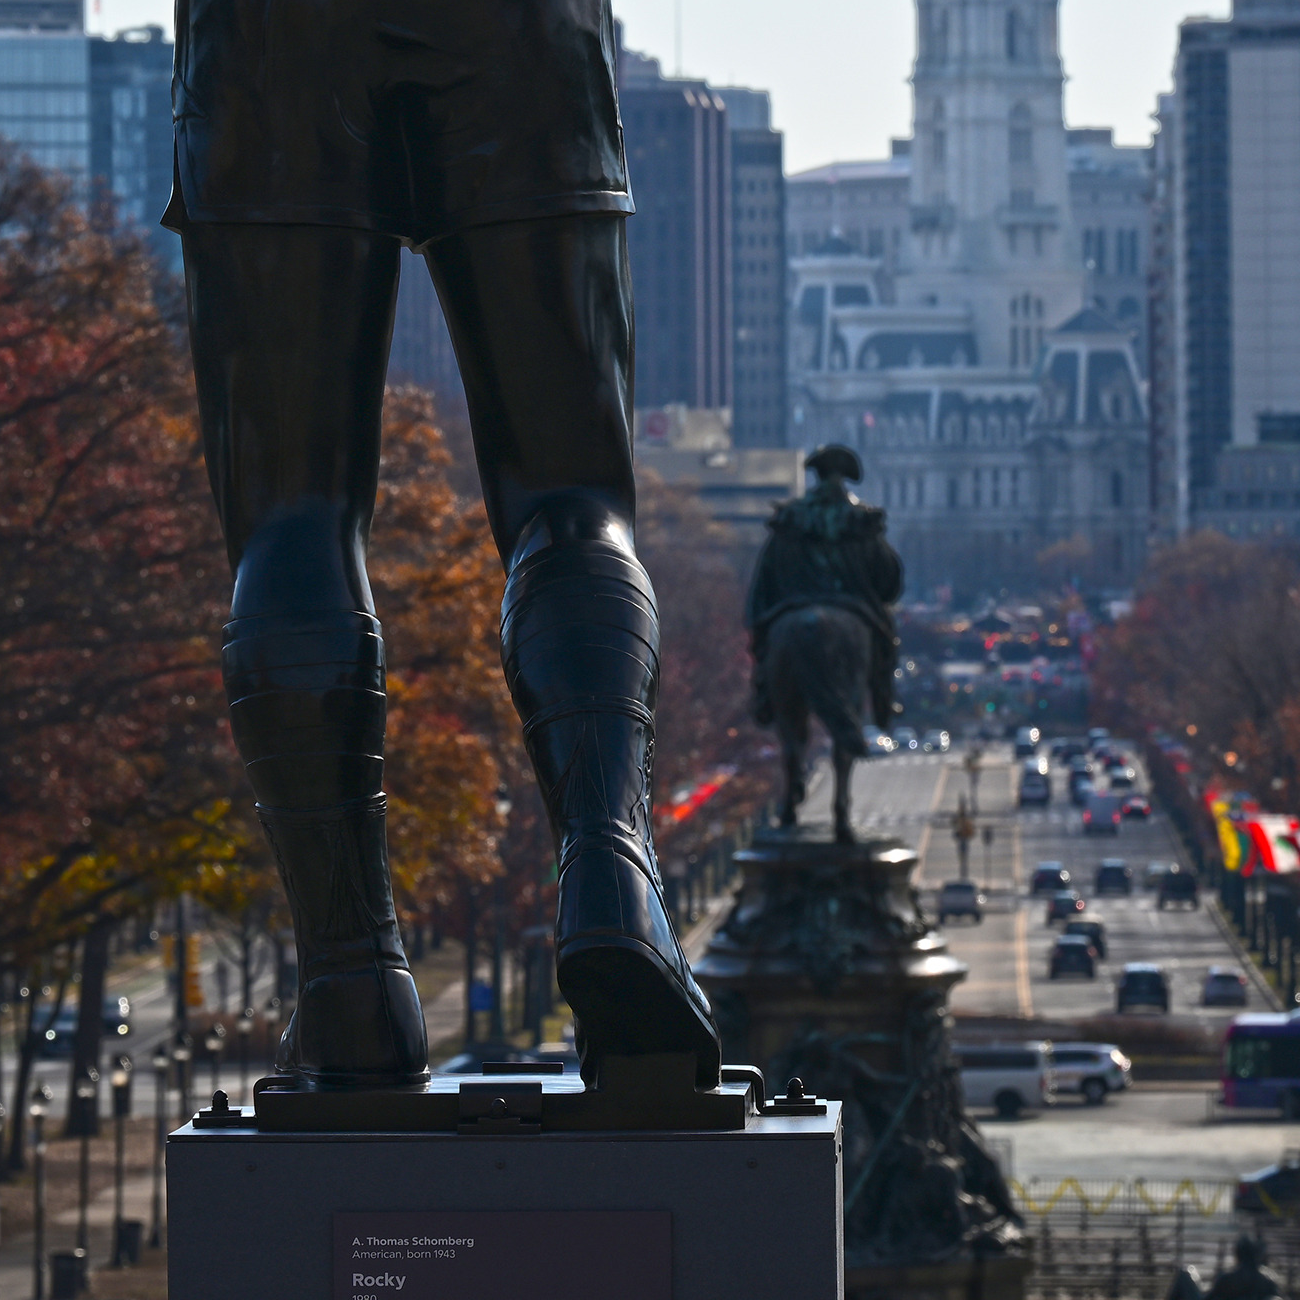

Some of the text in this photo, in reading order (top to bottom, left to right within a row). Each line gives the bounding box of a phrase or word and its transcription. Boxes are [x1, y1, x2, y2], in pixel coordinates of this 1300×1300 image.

[351, 1236, 474, 1248] A. Thomas Schomberg
[352, 1249, 456, 1260] American, born 1943
[352, 1272, 407, 1290] Rocky
